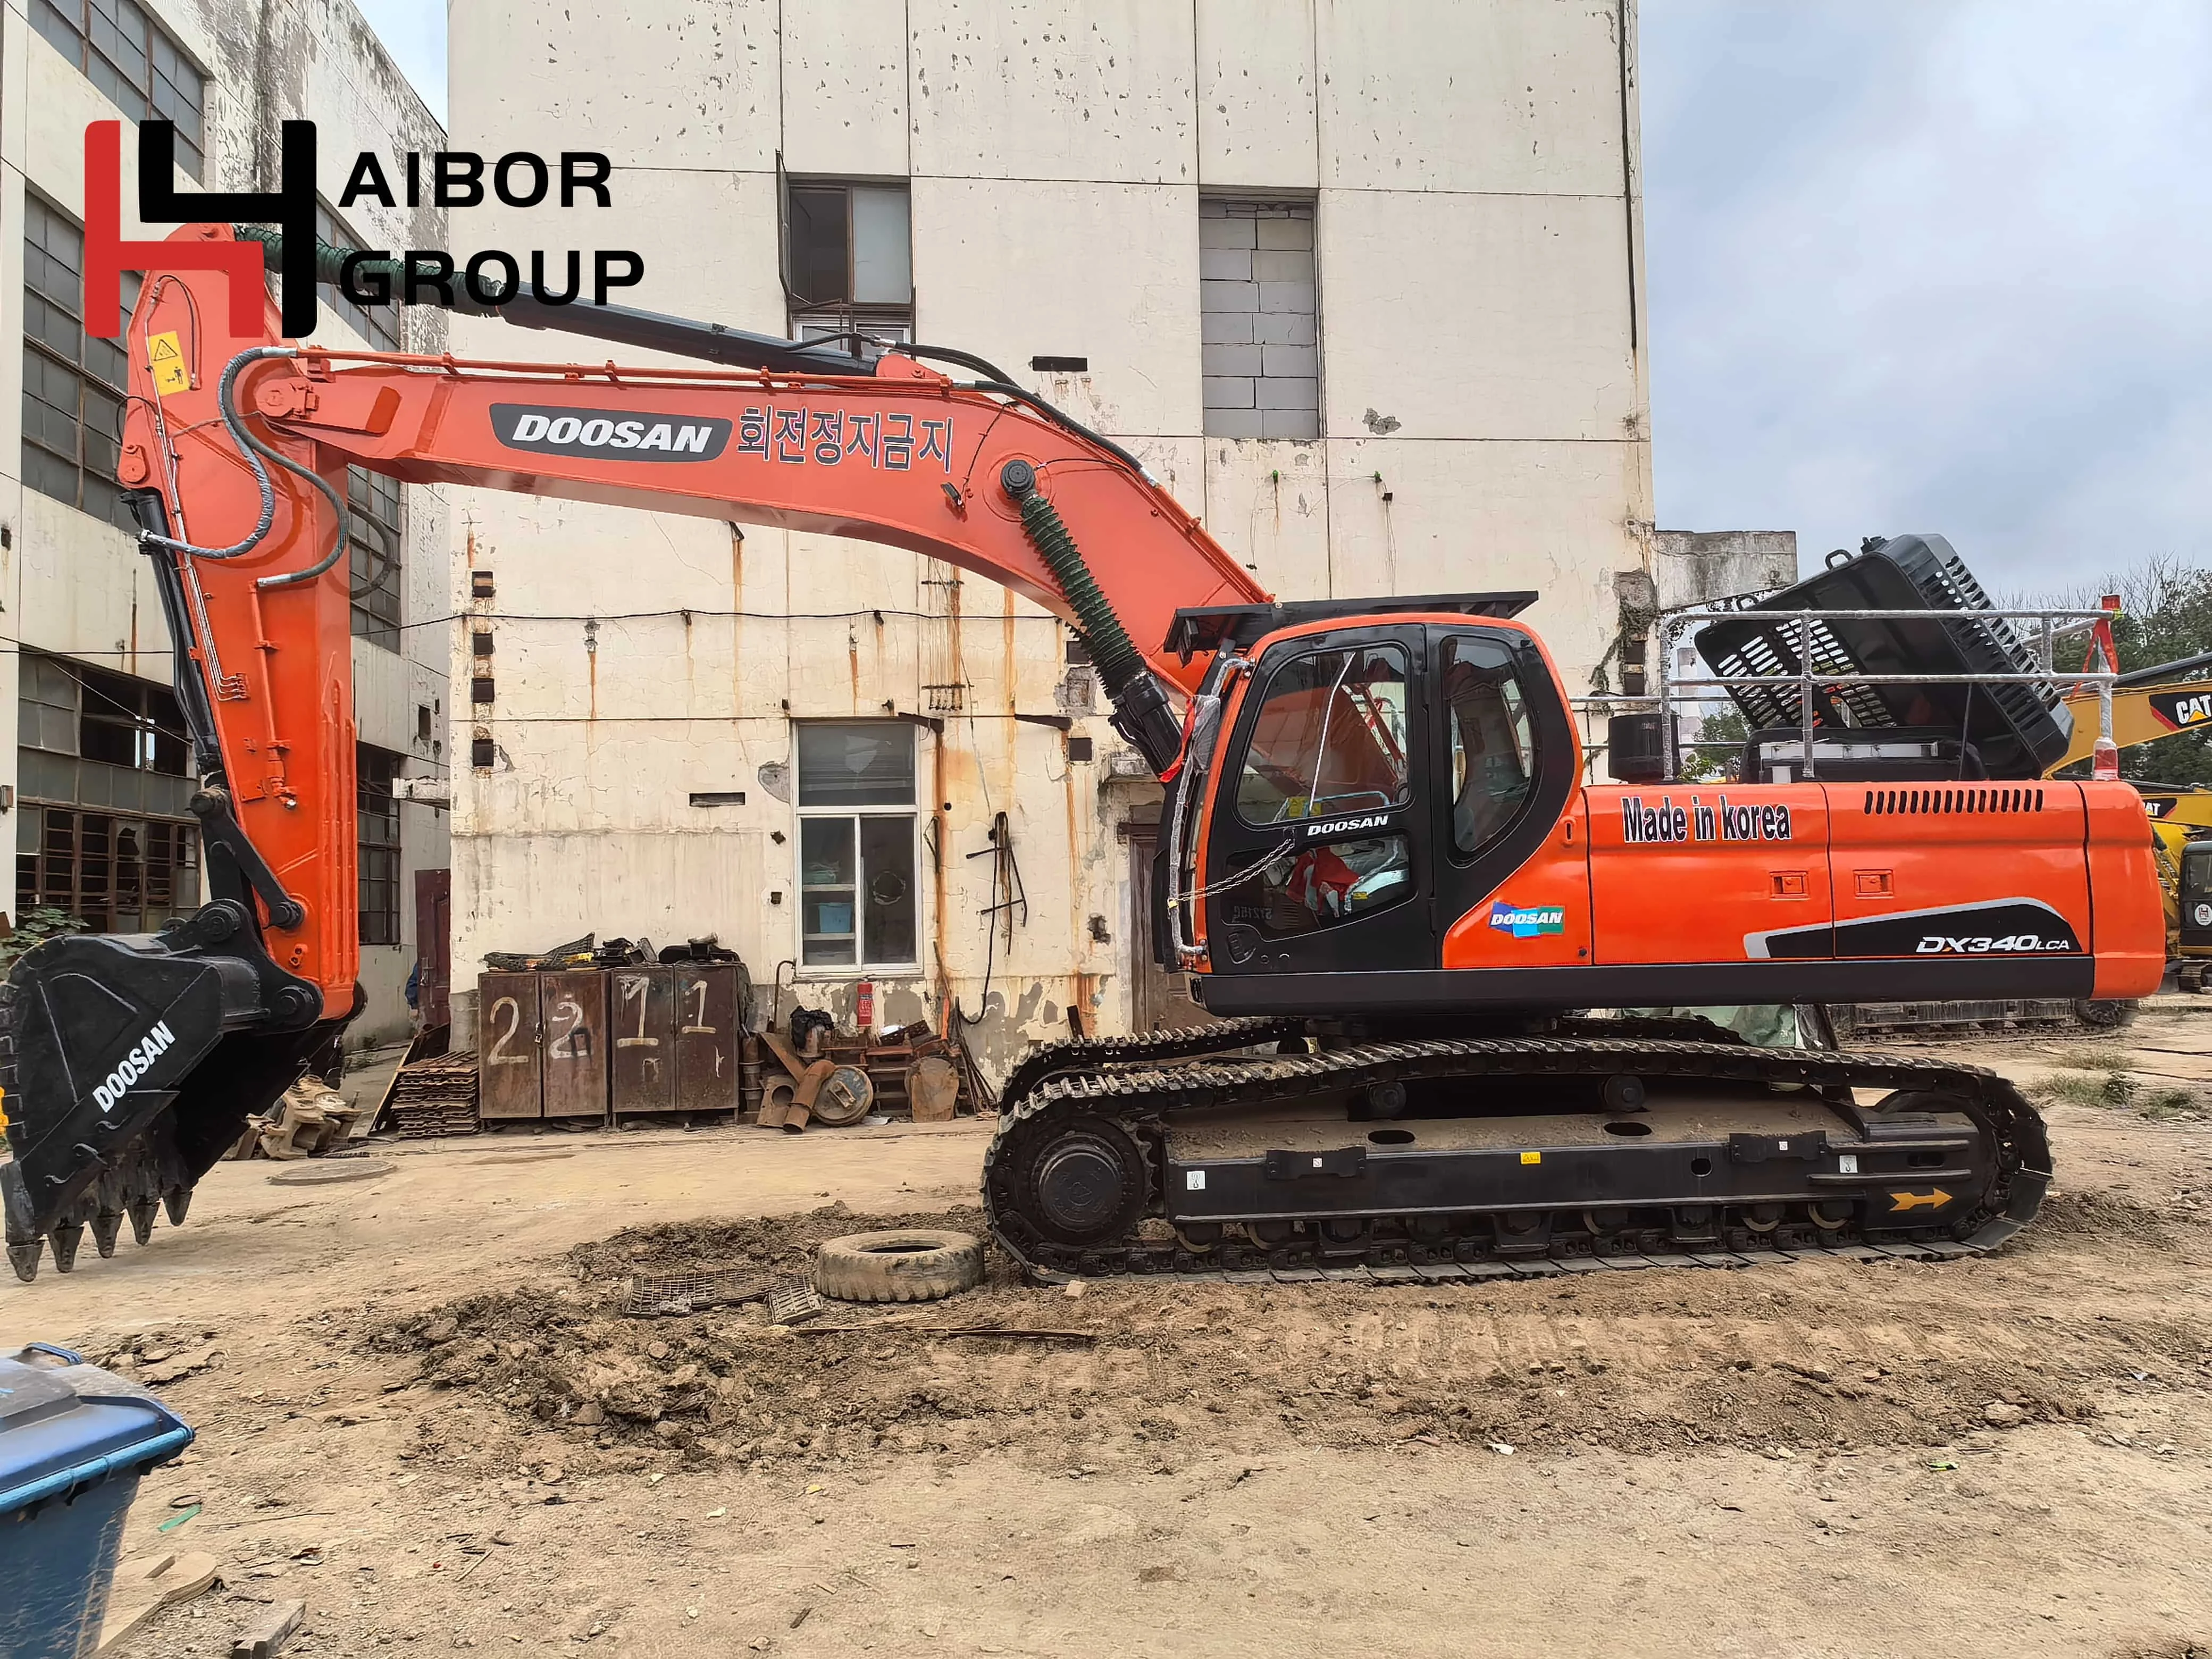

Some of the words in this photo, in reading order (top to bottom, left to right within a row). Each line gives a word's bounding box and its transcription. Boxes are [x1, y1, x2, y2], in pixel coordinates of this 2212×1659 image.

[512, 414, 713, 453] DOOSAN
[736, 405, 953, 474] 회전정지금지
[2176, 694, 2211, 724] CAT
[1307, 815, 1389, 836] DOOSAN
[1621, 795, 1688, 843] Made
[1691, 795, 1716, 841] in
[1719, 794, 1792, 841] korea
[2143, 802, 2161, 816] AT
[1490, 911, 1564, 925] DOOSAN
[488, 996, 529, 1065] 2
[549, 1001, 594, 1060] 2
[682, 980, 717, 1034] 1
[92, 1020, 177, 1113] DOOSAN
